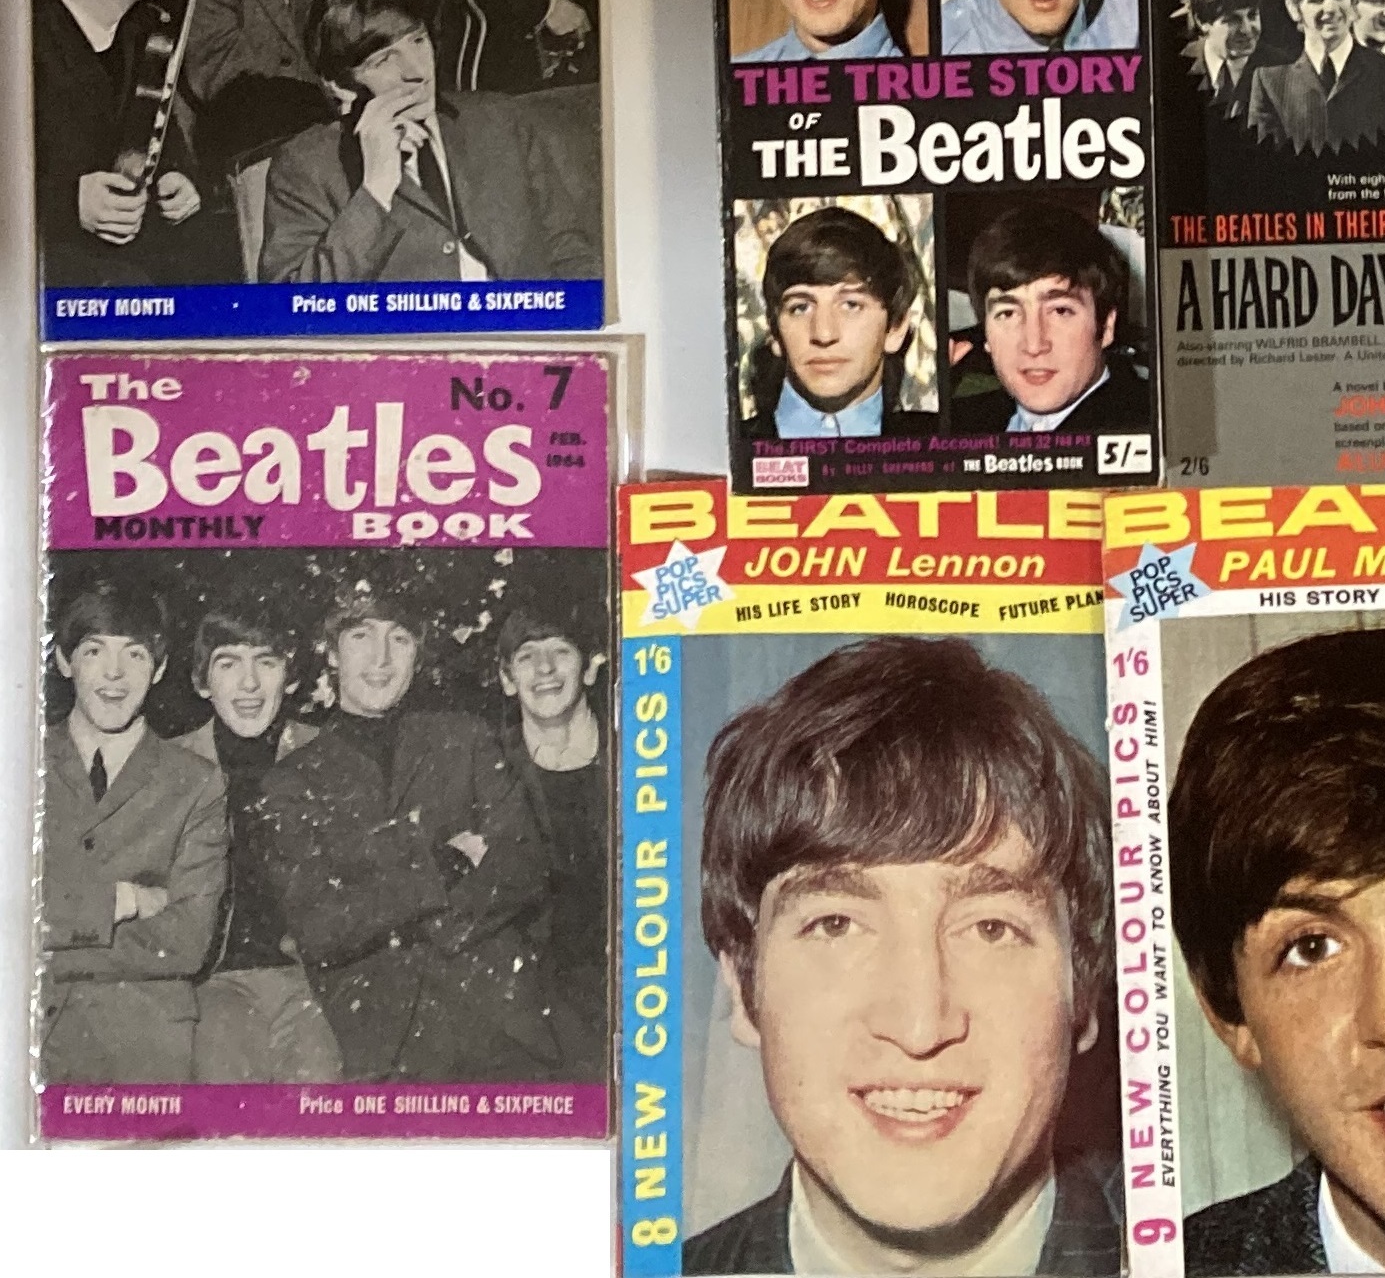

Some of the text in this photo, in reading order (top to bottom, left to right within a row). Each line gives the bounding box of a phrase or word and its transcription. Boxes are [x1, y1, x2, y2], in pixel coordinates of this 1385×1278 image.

[733, 56, 1143, 106] THE TRUE STORY
[789, 113, 821, 130] OF
[752, 98, 1146, 186] THE Beatles
[1327, 174, 1356, 185] With
[1328, 188, 1357, 200] from
[1360, 188, 1380, 200] the
[1171, 215, 1207, 243] THE
[1215, 213, 1298, 242] BEATLES
[1306, 212, 1325, 240] IN
[1176, 259, 1203, 331] A
[1211, 256, 1318, 330] HARD
[80, 374, 183, 401] The
[450, 366, 574, 411] No. 7
[82, 402, 542, 516] Beatles
[1102, 441, 1149, 468] 5/-
[352, 512, 535, 543] BOOK
[630, 490, 1104, 544] BEATLE
[744, 546, 1046, 579] JOHN Lennon
[1219, 549, 1336, 582] PAUL
[736, 593, 861, 622] HIS LIFE STORY
[885, 593, 980, 618] HOROSCOPE
[1260, 588, 1296, 607] HIS
[1307, 587, 1381, 605] STORY
[1113, 703, 1155, 1188] NEW COLOUR PICS
[631, 693, 678, 1246] 8 NEW COLOUR PICS
